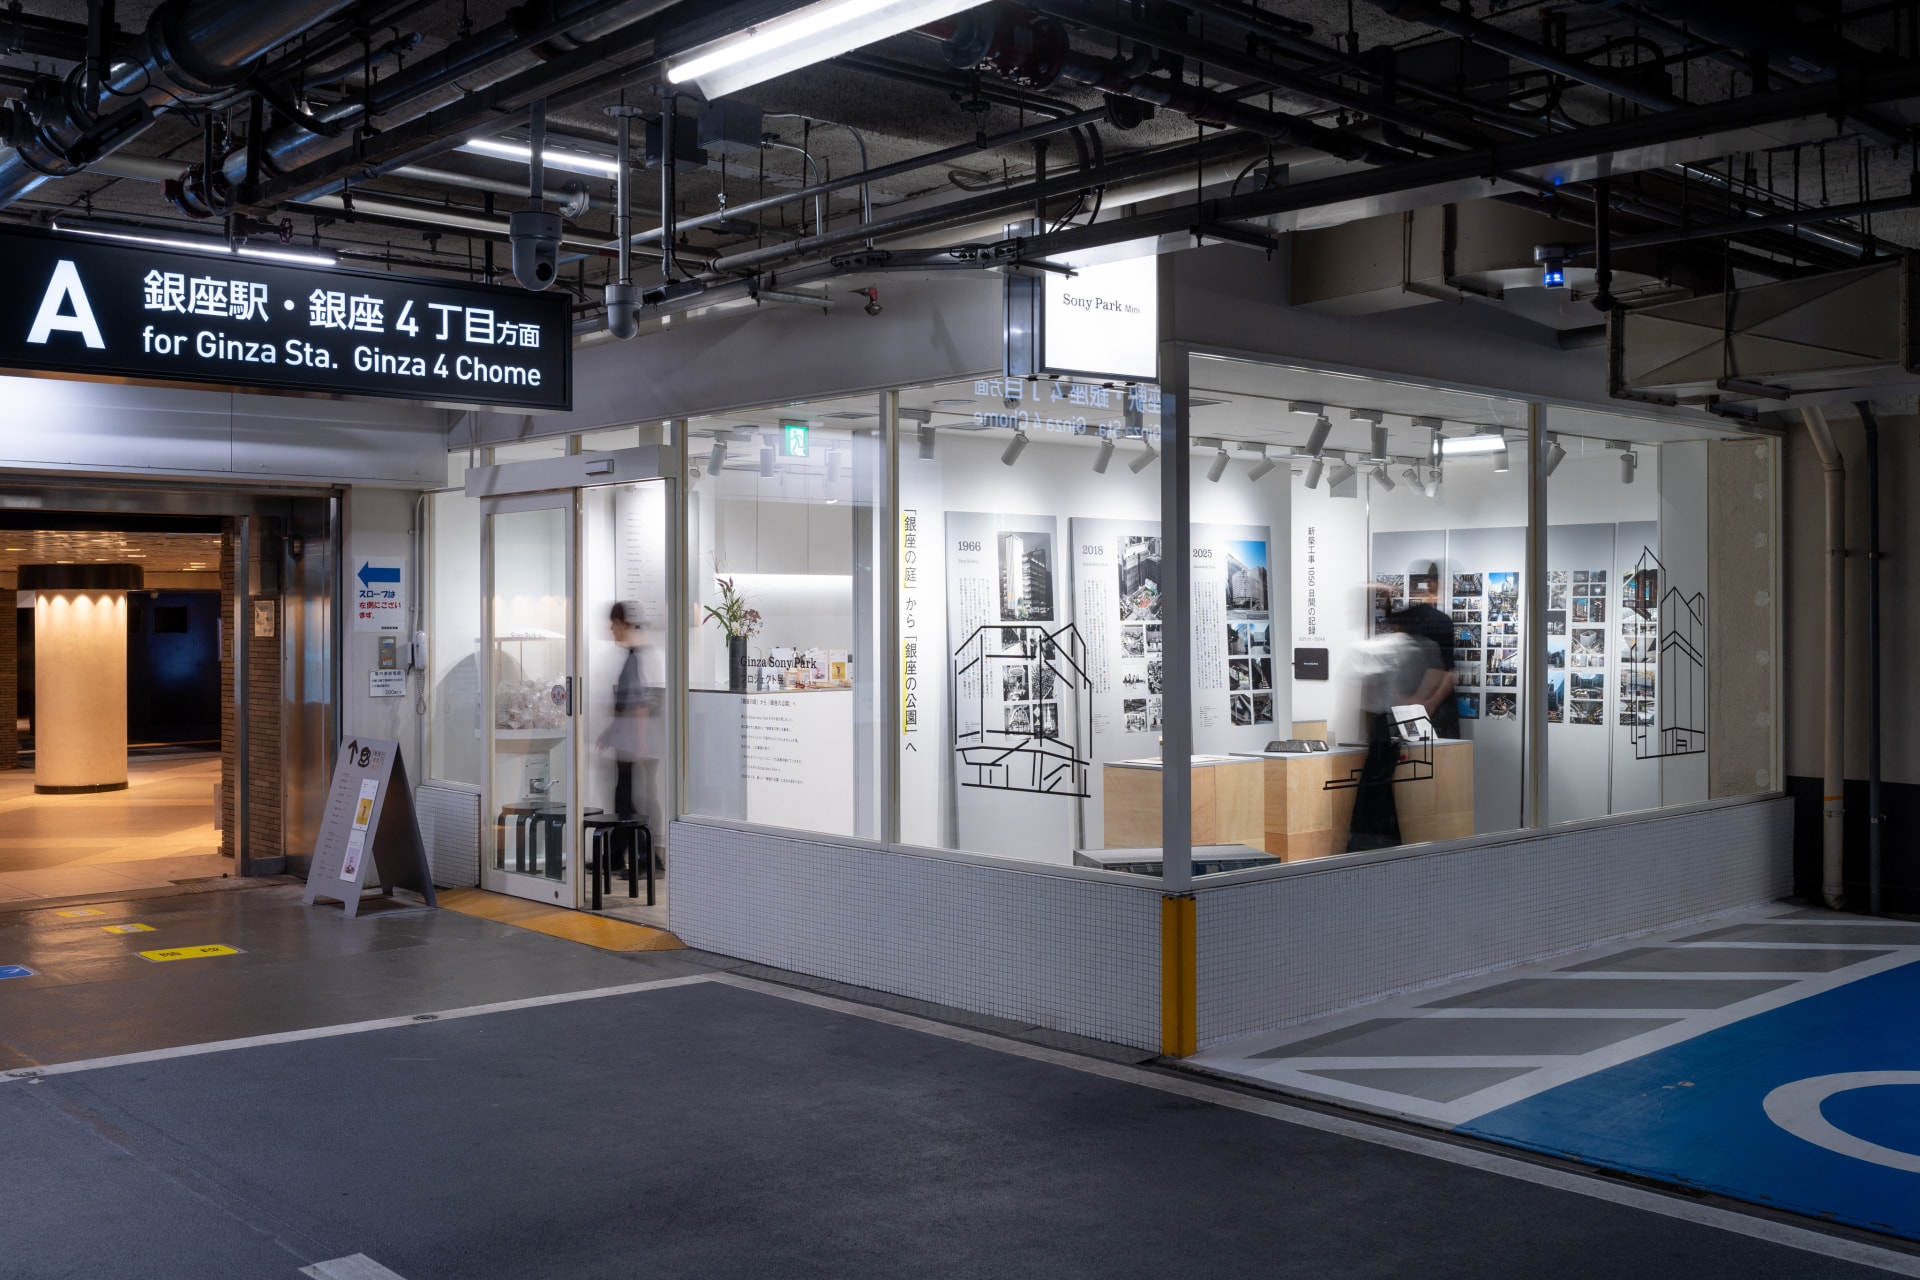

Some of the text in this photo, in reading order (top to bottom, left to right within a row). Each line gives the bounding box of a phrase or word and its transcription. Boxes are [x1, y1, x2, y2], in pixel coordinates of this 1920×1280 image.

[26, 259, 106, 350] A
[1063, 293, 1141, 314] Sony Park Mini
[143, 325, 541, 387] for Ginza Sta. Ginza 4 Chome
[957, 540, 982, 552] 1966
[1082, 545, 1104, 555] 2018
[1192, 549, 1213, 558] 2025
[359, 589, 396, 599] スロープは
[740, 656, 817, 671] Ginza Sony Park
